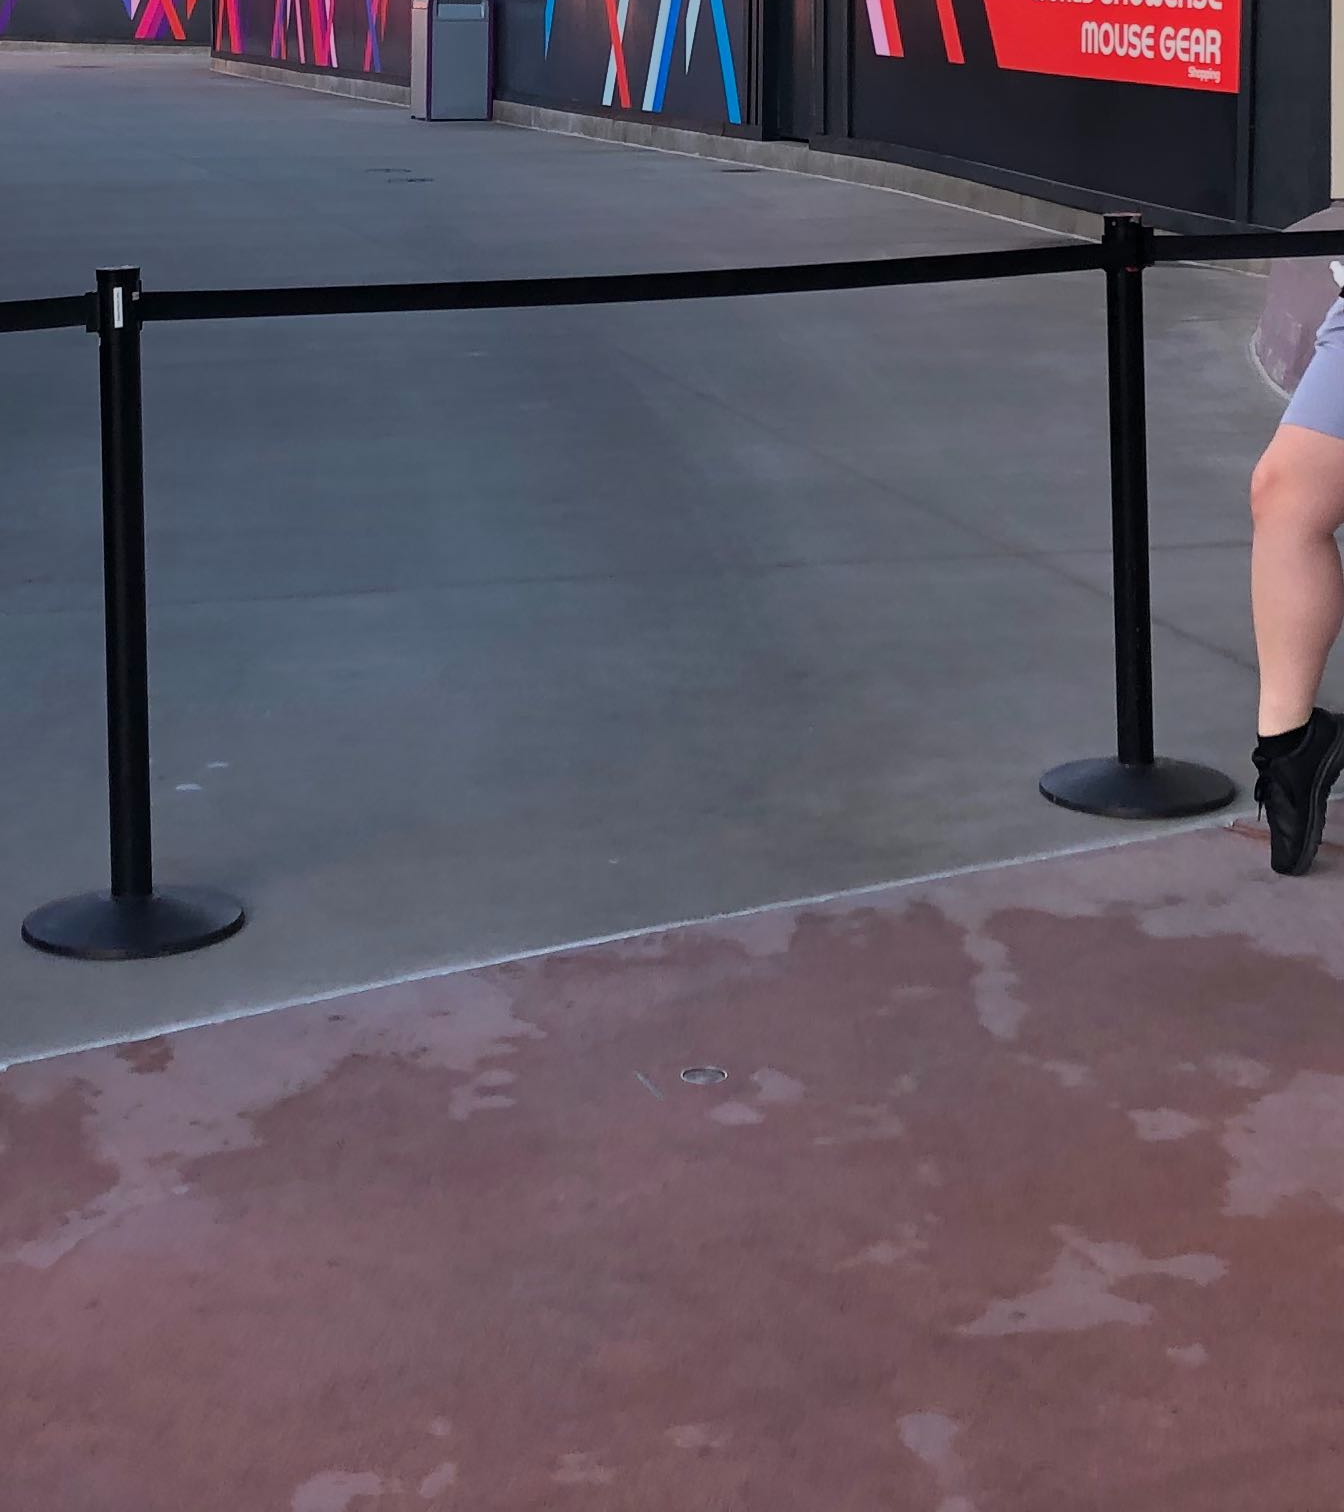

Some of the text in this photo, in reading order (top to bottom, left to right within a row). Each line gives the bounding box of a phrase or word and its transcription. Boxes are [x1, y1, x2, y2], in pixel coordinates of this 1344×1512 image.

[1080, 20, 1222, 65] MOUSE GEAR
[1187, 65, 1222, 84] Shopping
